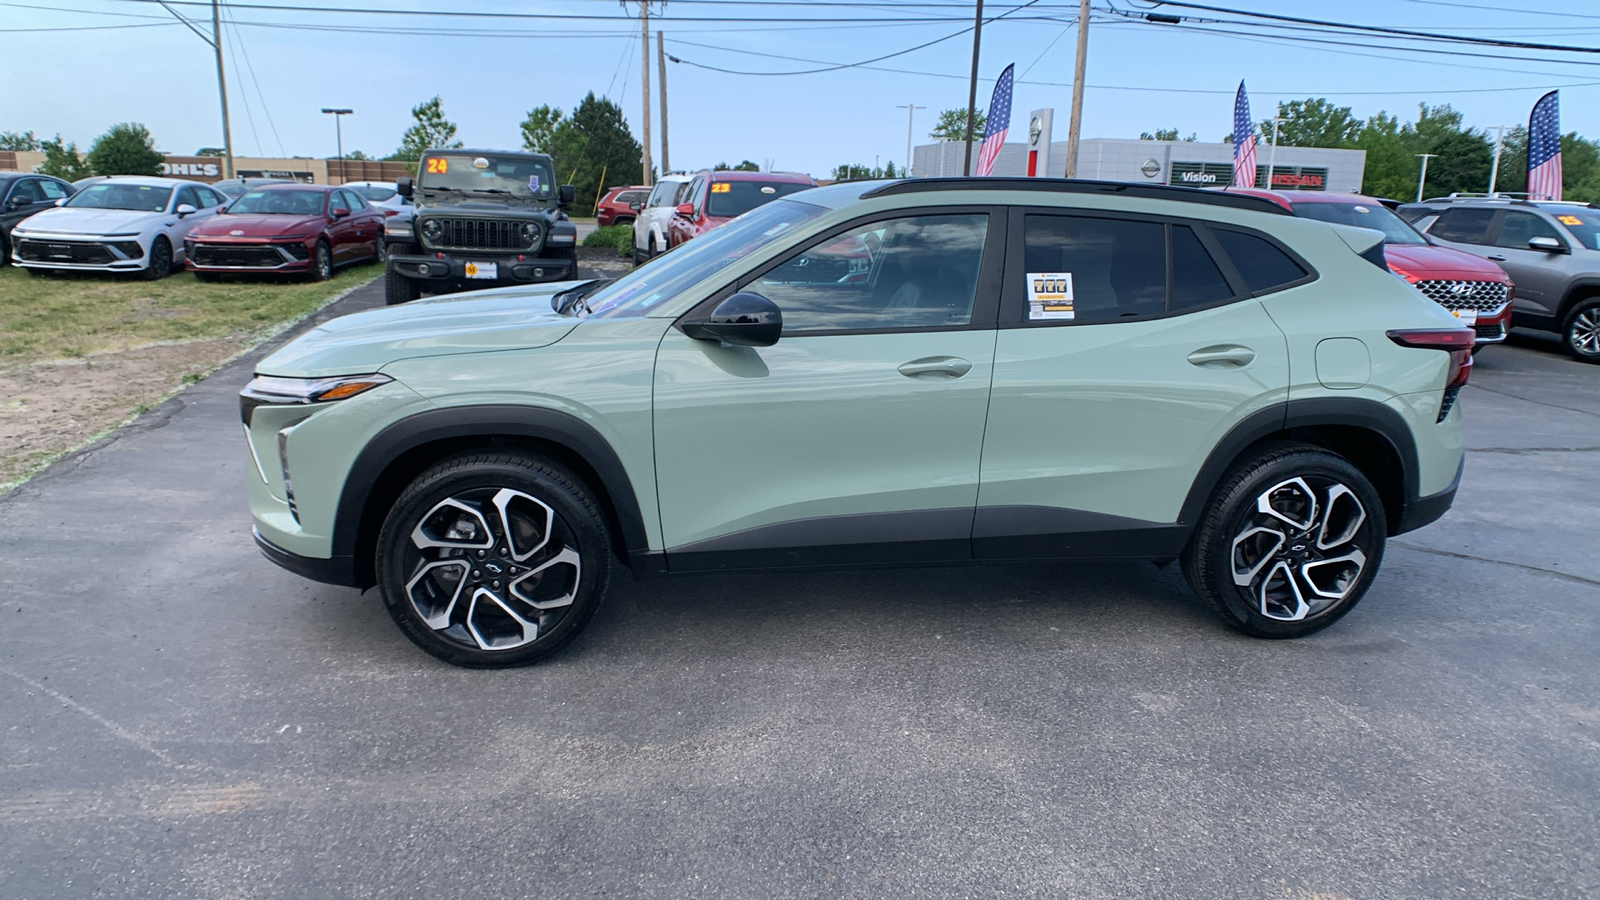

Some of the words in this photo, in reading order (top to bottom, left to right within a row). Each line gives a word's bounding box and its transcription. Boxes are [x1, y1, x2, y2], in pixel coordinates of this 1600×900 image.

[156, 162, 219, 176] OHL'S
[427, 158, 448, 173] 24
[1181, 171, 1216, 182] Vision
[711, 183, 730, 193] 23
[1557, 215, 1582, 225] 25
